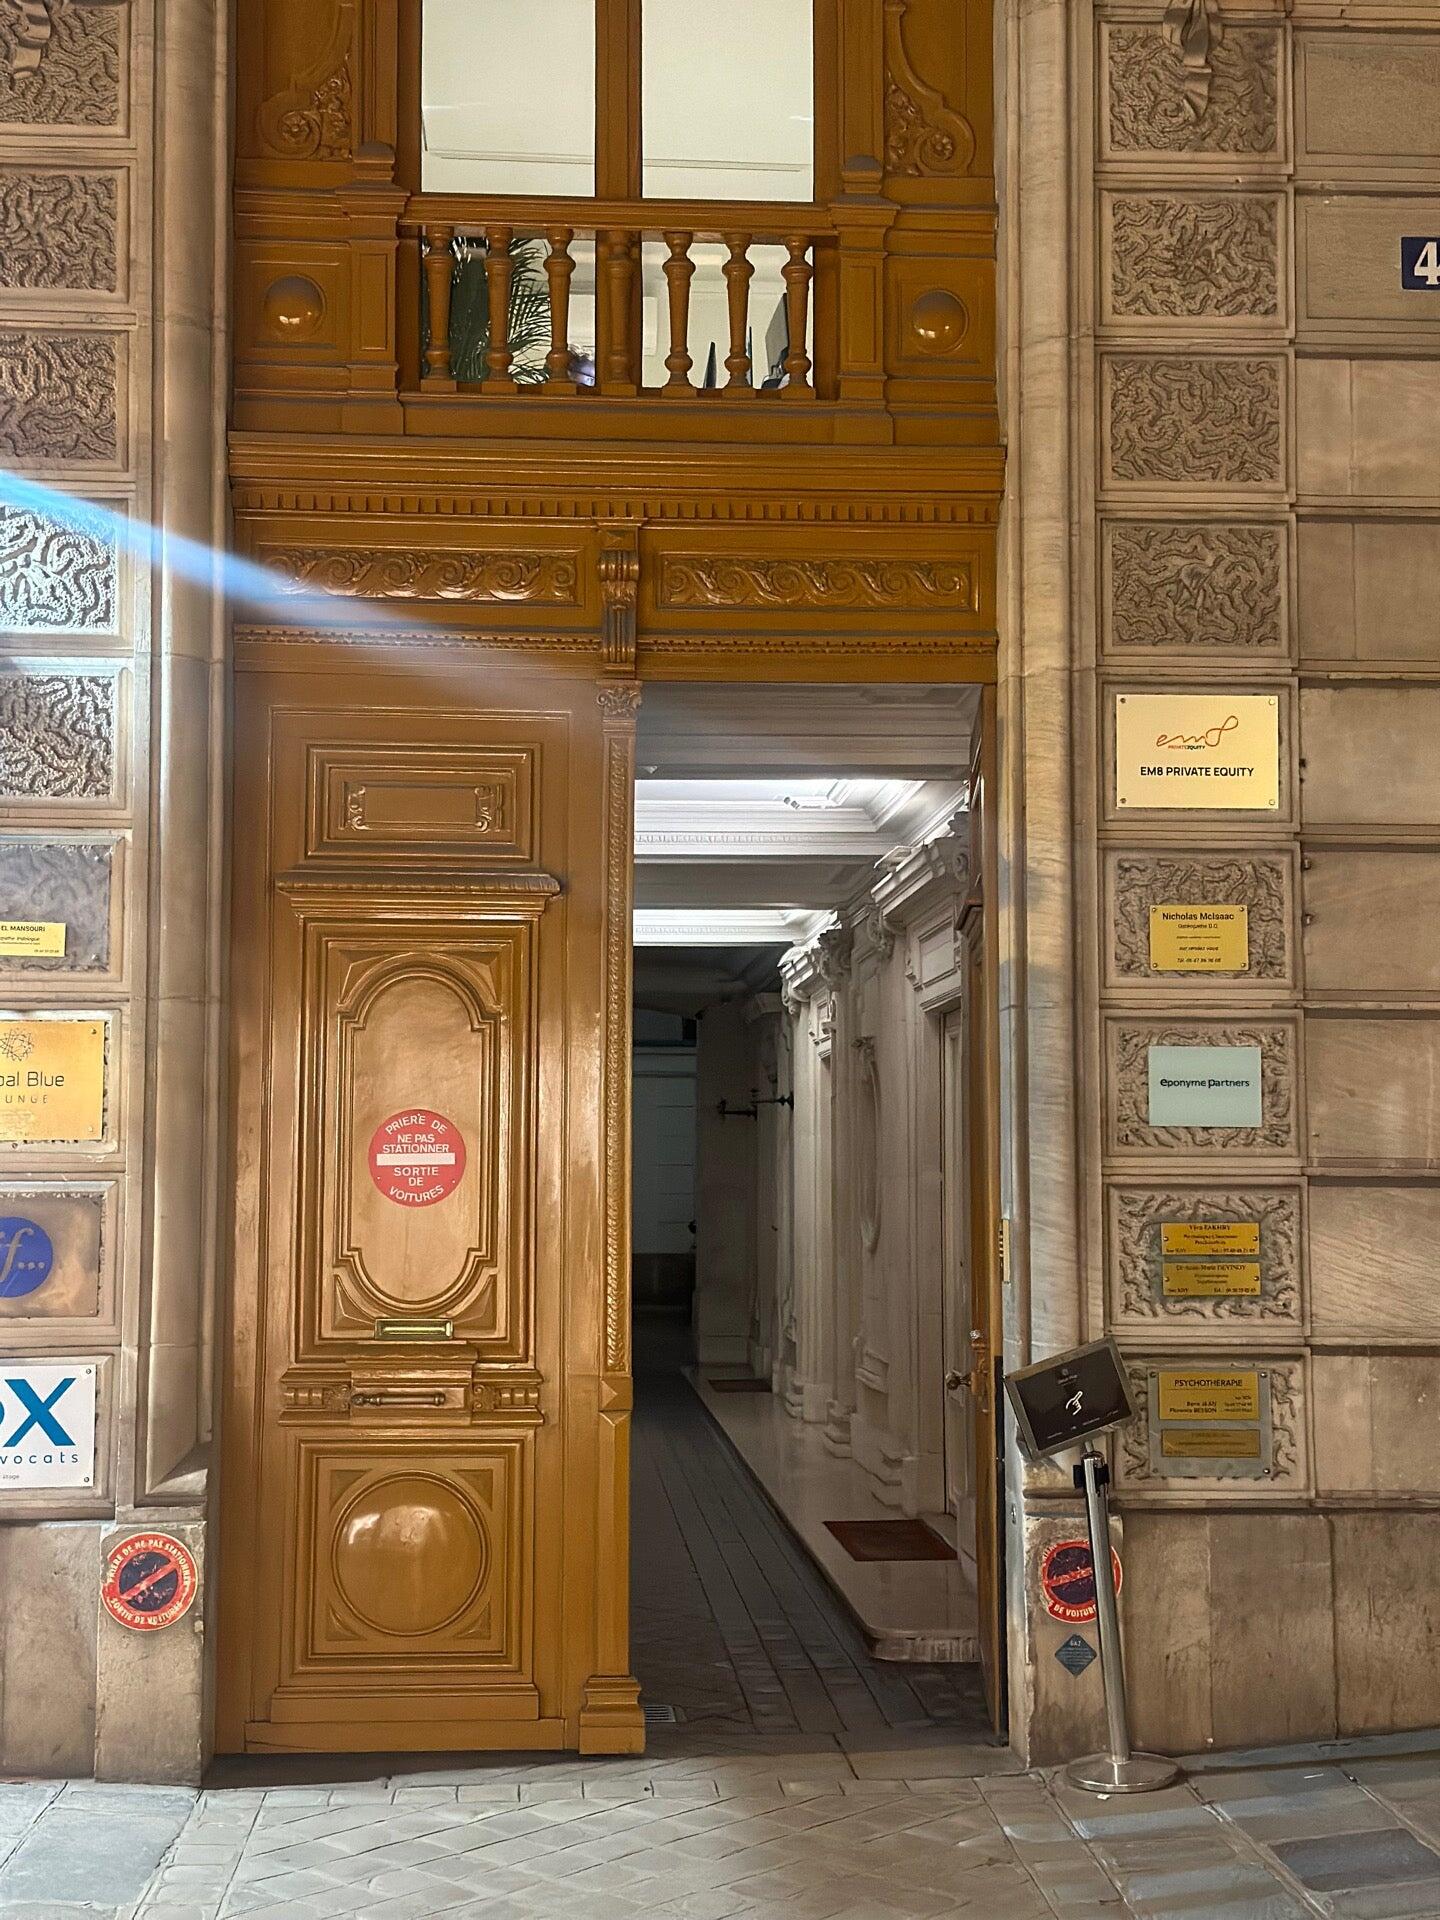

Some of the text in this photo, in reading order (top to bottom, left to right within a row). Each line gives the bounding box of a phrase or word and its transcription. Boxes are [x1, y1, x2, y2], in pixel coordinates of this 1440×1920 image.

[1140, 766, 1254, 777] EM8 PRIVATE EQUITY
[1162, 911, 1234, 920] Nicholas McIsaac
[27, 1071, 65, 1087] Blue
[1160, 1079, 1250, 1089] eponyme partners
[385, 1115, 448, 1135] PRIERE DE
[397, 1133, 435, 1143] NE PAS
[382, 1143, 449, 1153] STATIONNER
[393, 1166, 439, 1177] SORTIE
[408, 1177, 424, 1186] DE
[389, 1184, 445, 1202] VOITURES
[122, 1546, 134, 1556] DE
[134, 1540, 147, 1549] NE
[148, 1539, 164, 1549] PAS
[110, 1597, 134, 1621] SORTIE
[134, 1615, 145, 1625] DE
[1054, 1604, 1065, 1614] DE
